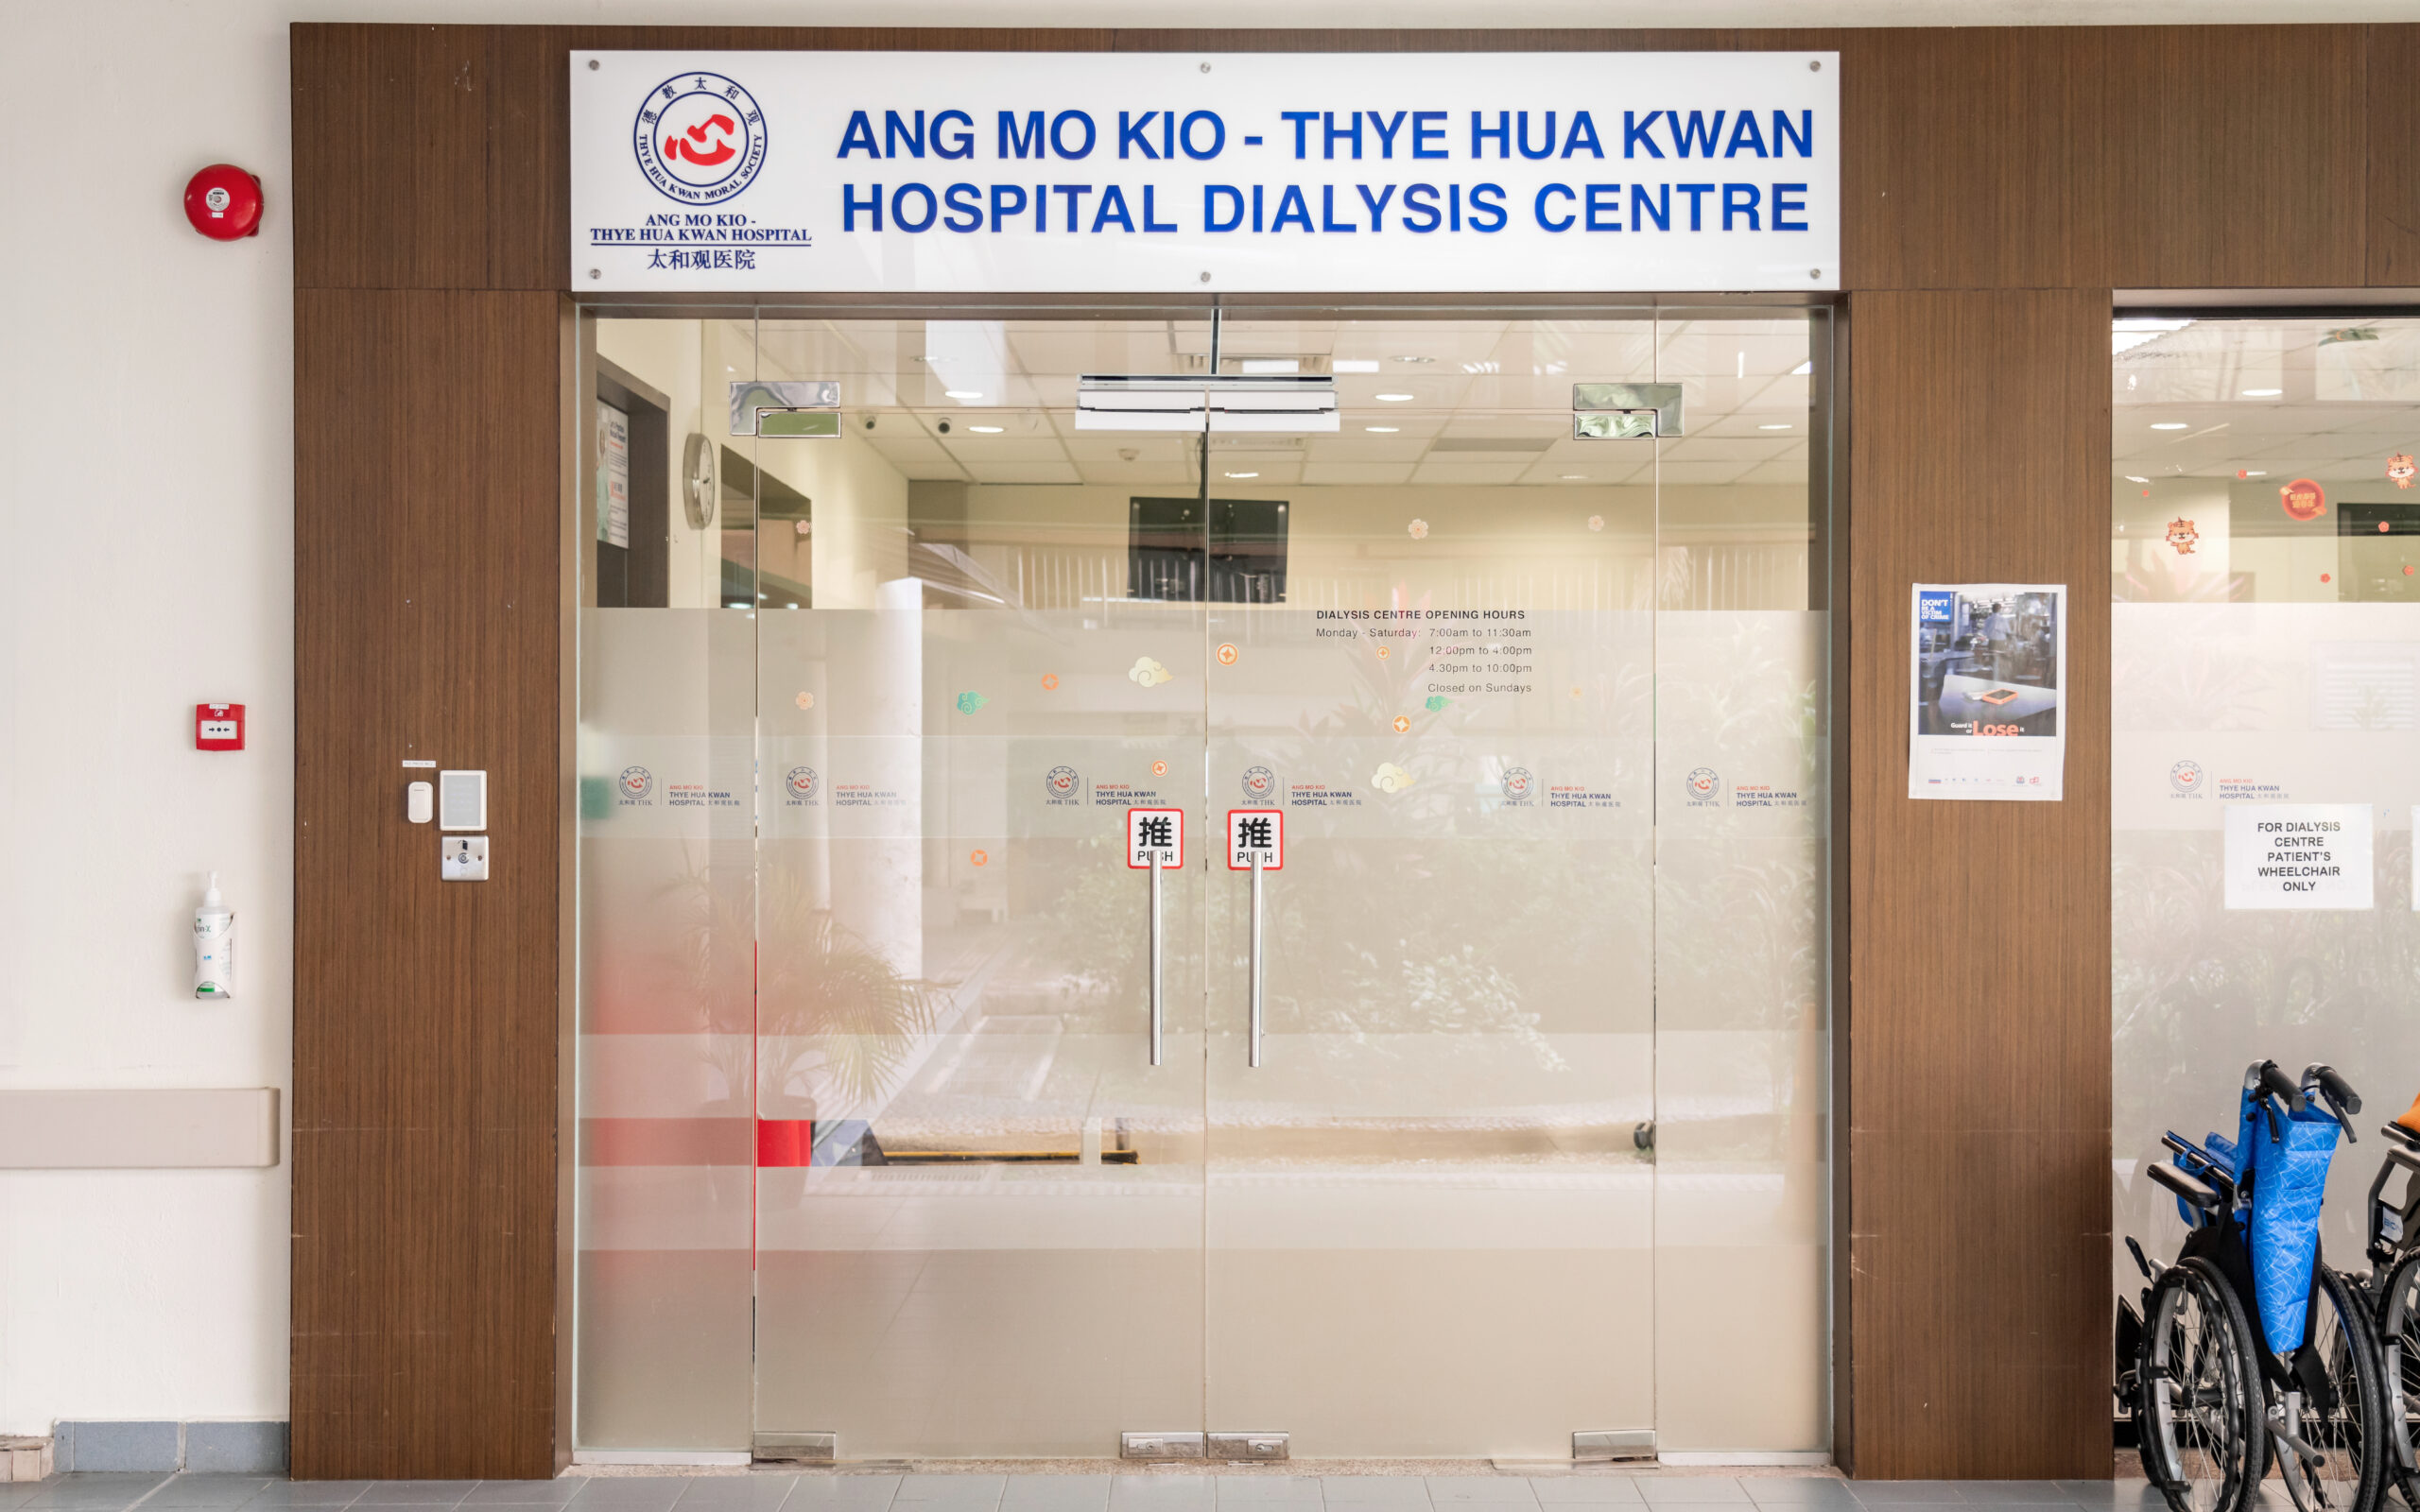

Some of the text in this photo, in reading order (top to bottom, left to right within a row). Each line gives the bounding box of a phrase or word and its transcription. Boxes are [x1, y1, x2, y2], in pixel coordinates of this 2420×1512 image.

[837, 109, 975, 161] ANG
[997, 110, 1097, 161] MO
[1117, 110, 1226, 161] KIO
[1281, 111, 1449, 160] THYE
[1471, 111, 1605, 161] HUA
[1623, 109, 1813, 160] KWAN
[639, 133, 763, 200] THYE HUA KWAN MORAL SOCIETY
[842, 182, 1809, 233] HOSPITAL DIALYSIS CENTRE
[646, 214, 681, 227] ANG
[685, 214, 713, 227] MO
[717, 214, 747, 227] KIO
[590, 229, 812, 241] THYE HUA KWAN HOSPITAL
[647, 249, 756, 270] 太和观医院
[1316, 610, 1525, 620] DIALYSIS CENTRE OPENING HOURS
[1316, 628, 1357, 640] Monday
[1429, 628, 1468, 638] 7:00am
[1472, 628, 1482, 638] to
[1487, 628, 1531, 638] 11:30am
[1478, 645, 1489, 655] to
[1472, 663, 1482, 673] to
[1487, 663, 1532, 675] 10:00pm
[1427, 683, 1465, 693] Closed
[1485, 683, 1531, 695] Sundays
[1972, 720, 2019, 736] Lose
[1138, 816, 1173, 848] 推
[1237, 816, 1272, 849] 推
[2257, 821, 2341, 833] FOR DIALYSIS
[2274, 836, 2325, 847] CENTRE
[1137, 850, 1173, 862] PH
[1236, 851, 1273, 863] PUH
[2268, 851, 2331, 862] PATIENT'S
[2257, 867, 2341, 877] WHEELCHAIR
[2283, 882, 2316, 892] ONLY
